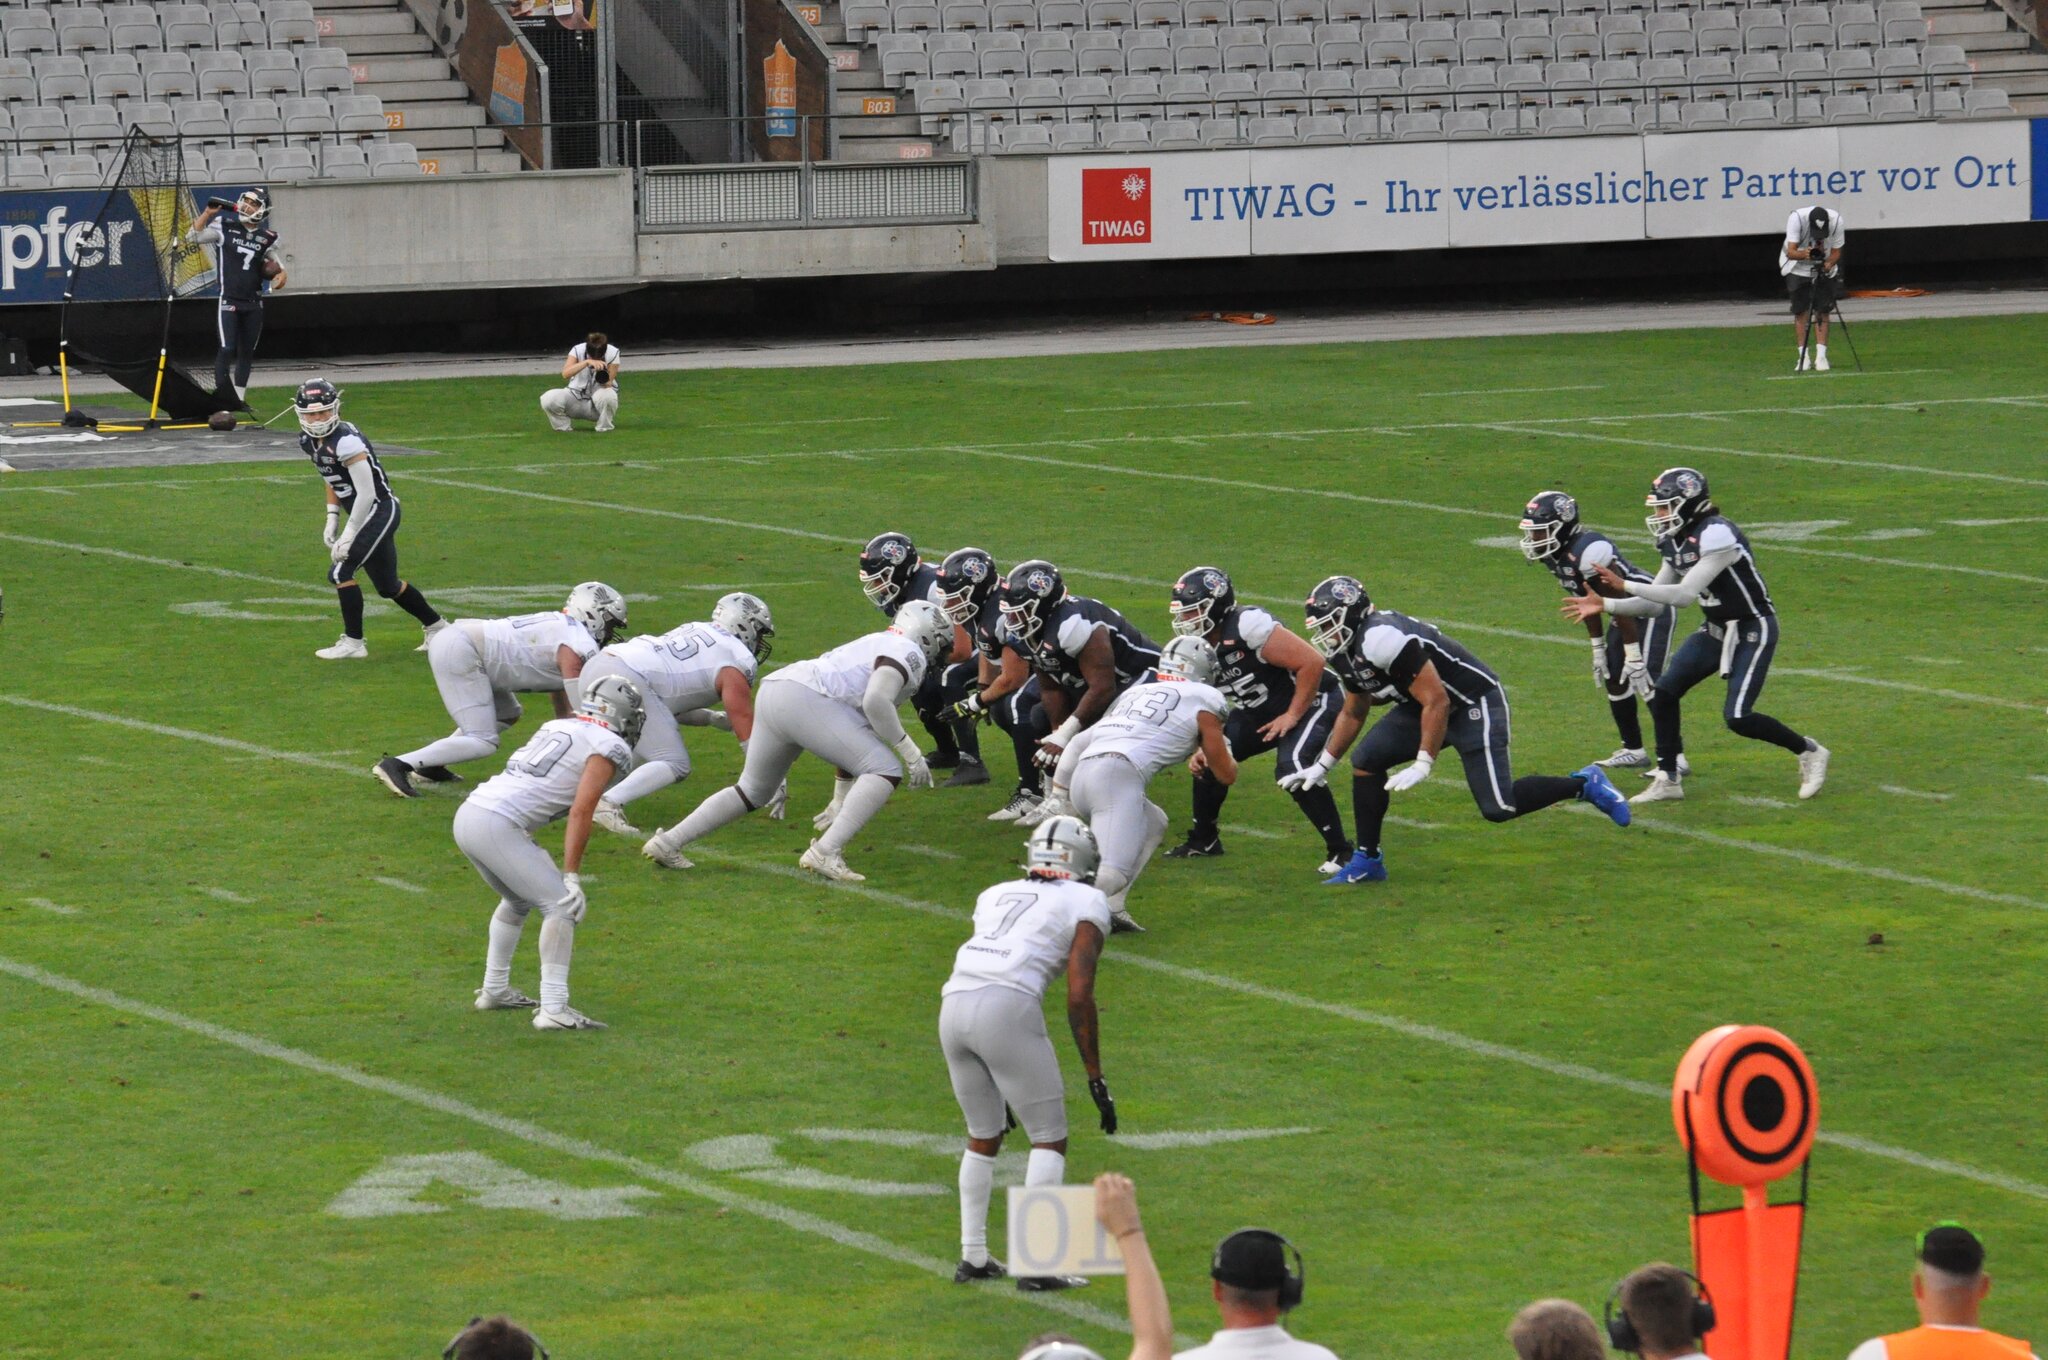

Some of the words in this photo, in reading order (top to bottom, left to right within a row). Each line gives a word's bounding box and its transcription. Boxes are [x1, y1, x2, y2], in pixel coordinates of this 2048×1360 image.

[867, 101, 890, 113] B03
[1183, 183, 1337, 222] TIWAG
[1385, 179, 1441, 214] Ihr
[1453, 170, 1710, 211] verlässlicher
[1721, 165, 1866, 200] Partner
[1877, 166, 1939, 193] vor
[1953, 155, 2017, 190] Ort
[1088, 219, 1146, 238] TIWAG
[0, 205, 134, 290] pfer
[232, 237, 262, 251] MILANO
[236, 246, 256, 270] 7
[983, 892, 1039, 941] 7
